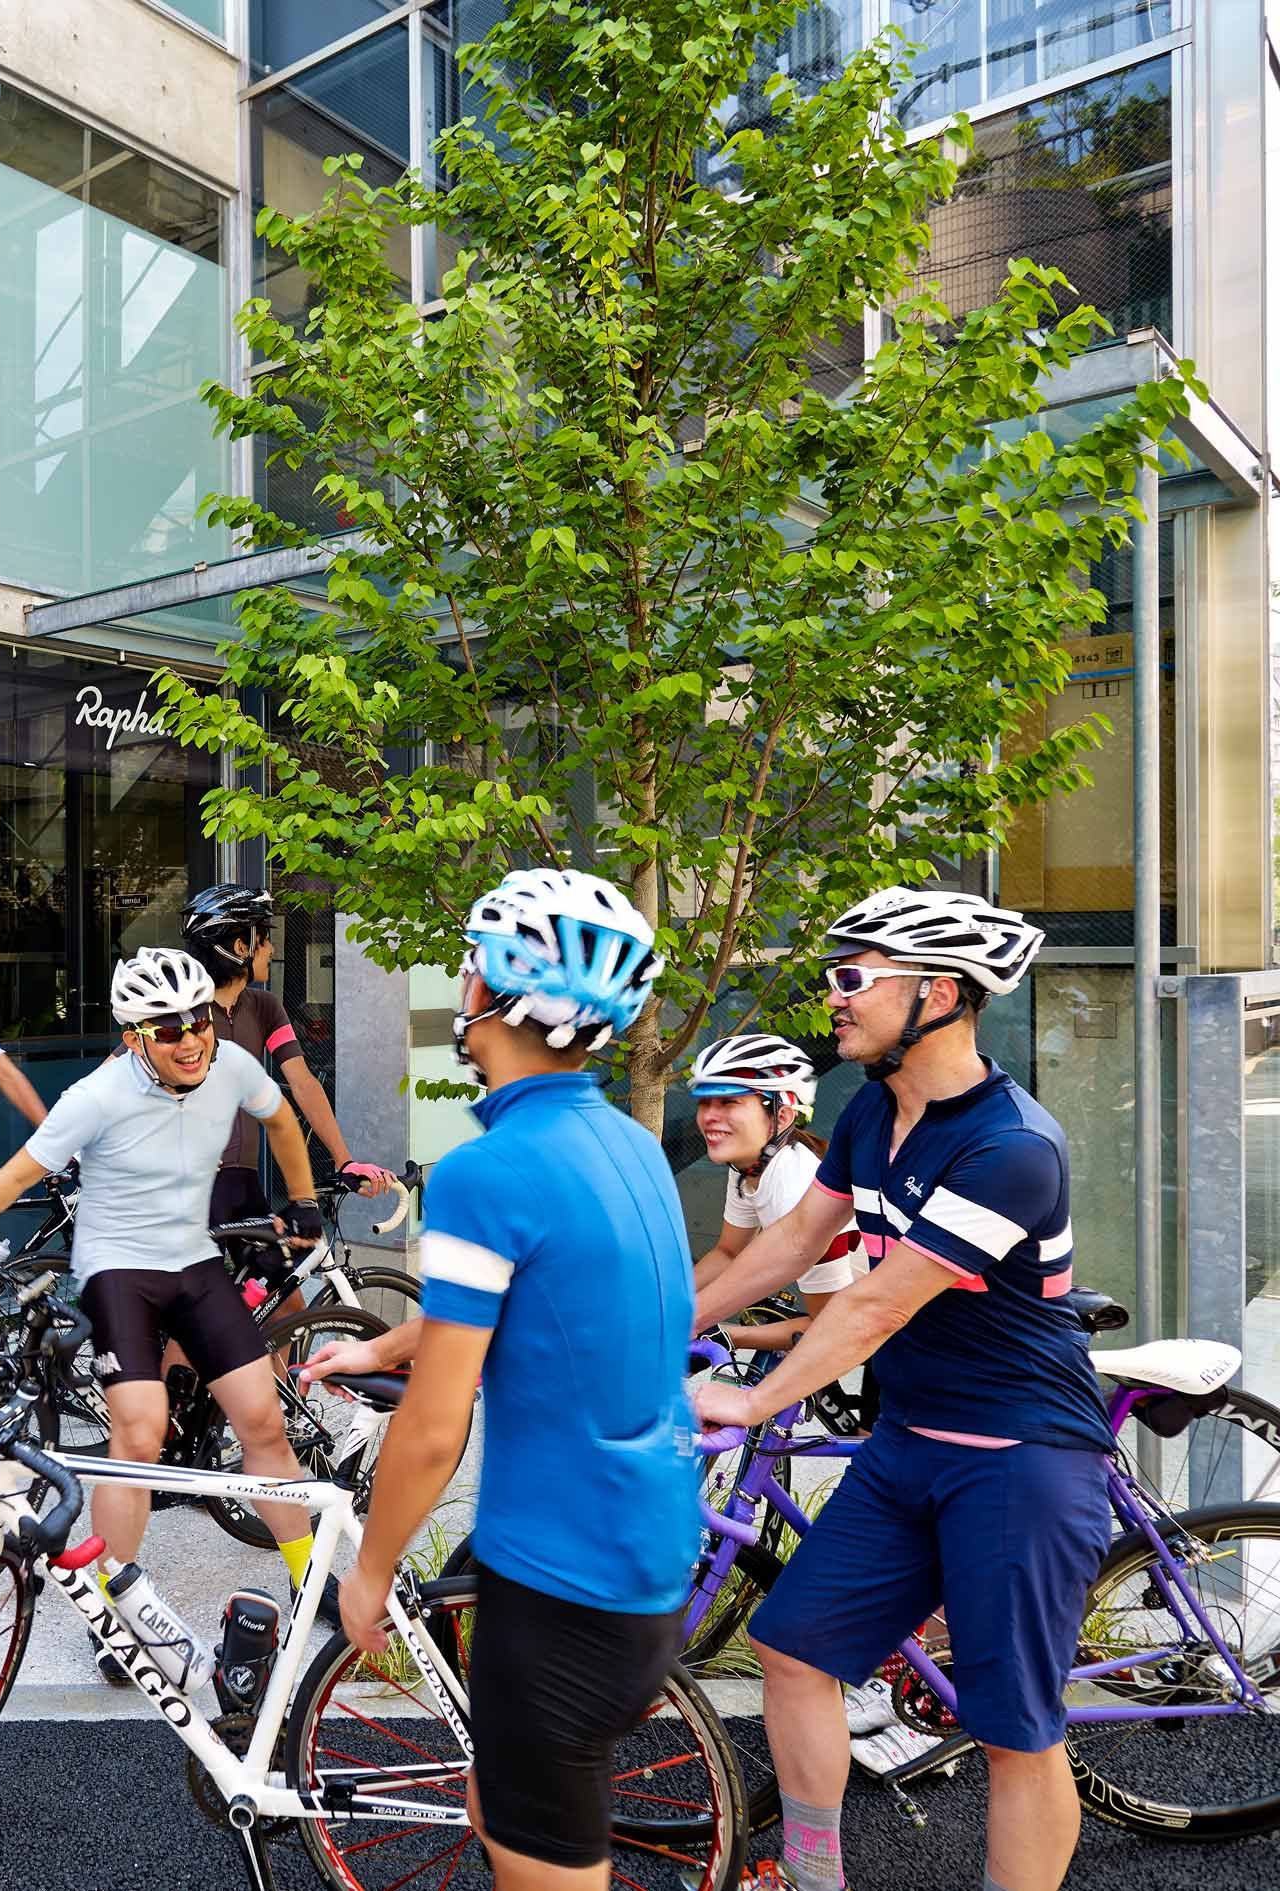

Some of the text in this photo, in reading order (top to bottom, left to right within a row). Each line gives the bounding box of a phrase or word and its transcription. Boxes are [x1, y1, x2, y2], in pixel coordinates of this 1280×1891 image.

[226, 1484, 307, 1500] COLNAGO
[237, 1613, 267, 1632] Vittoria
[47, 1558, 192, 1729] OLNAGO
[371, 1805, 448, 1820] TEAM EDITION
